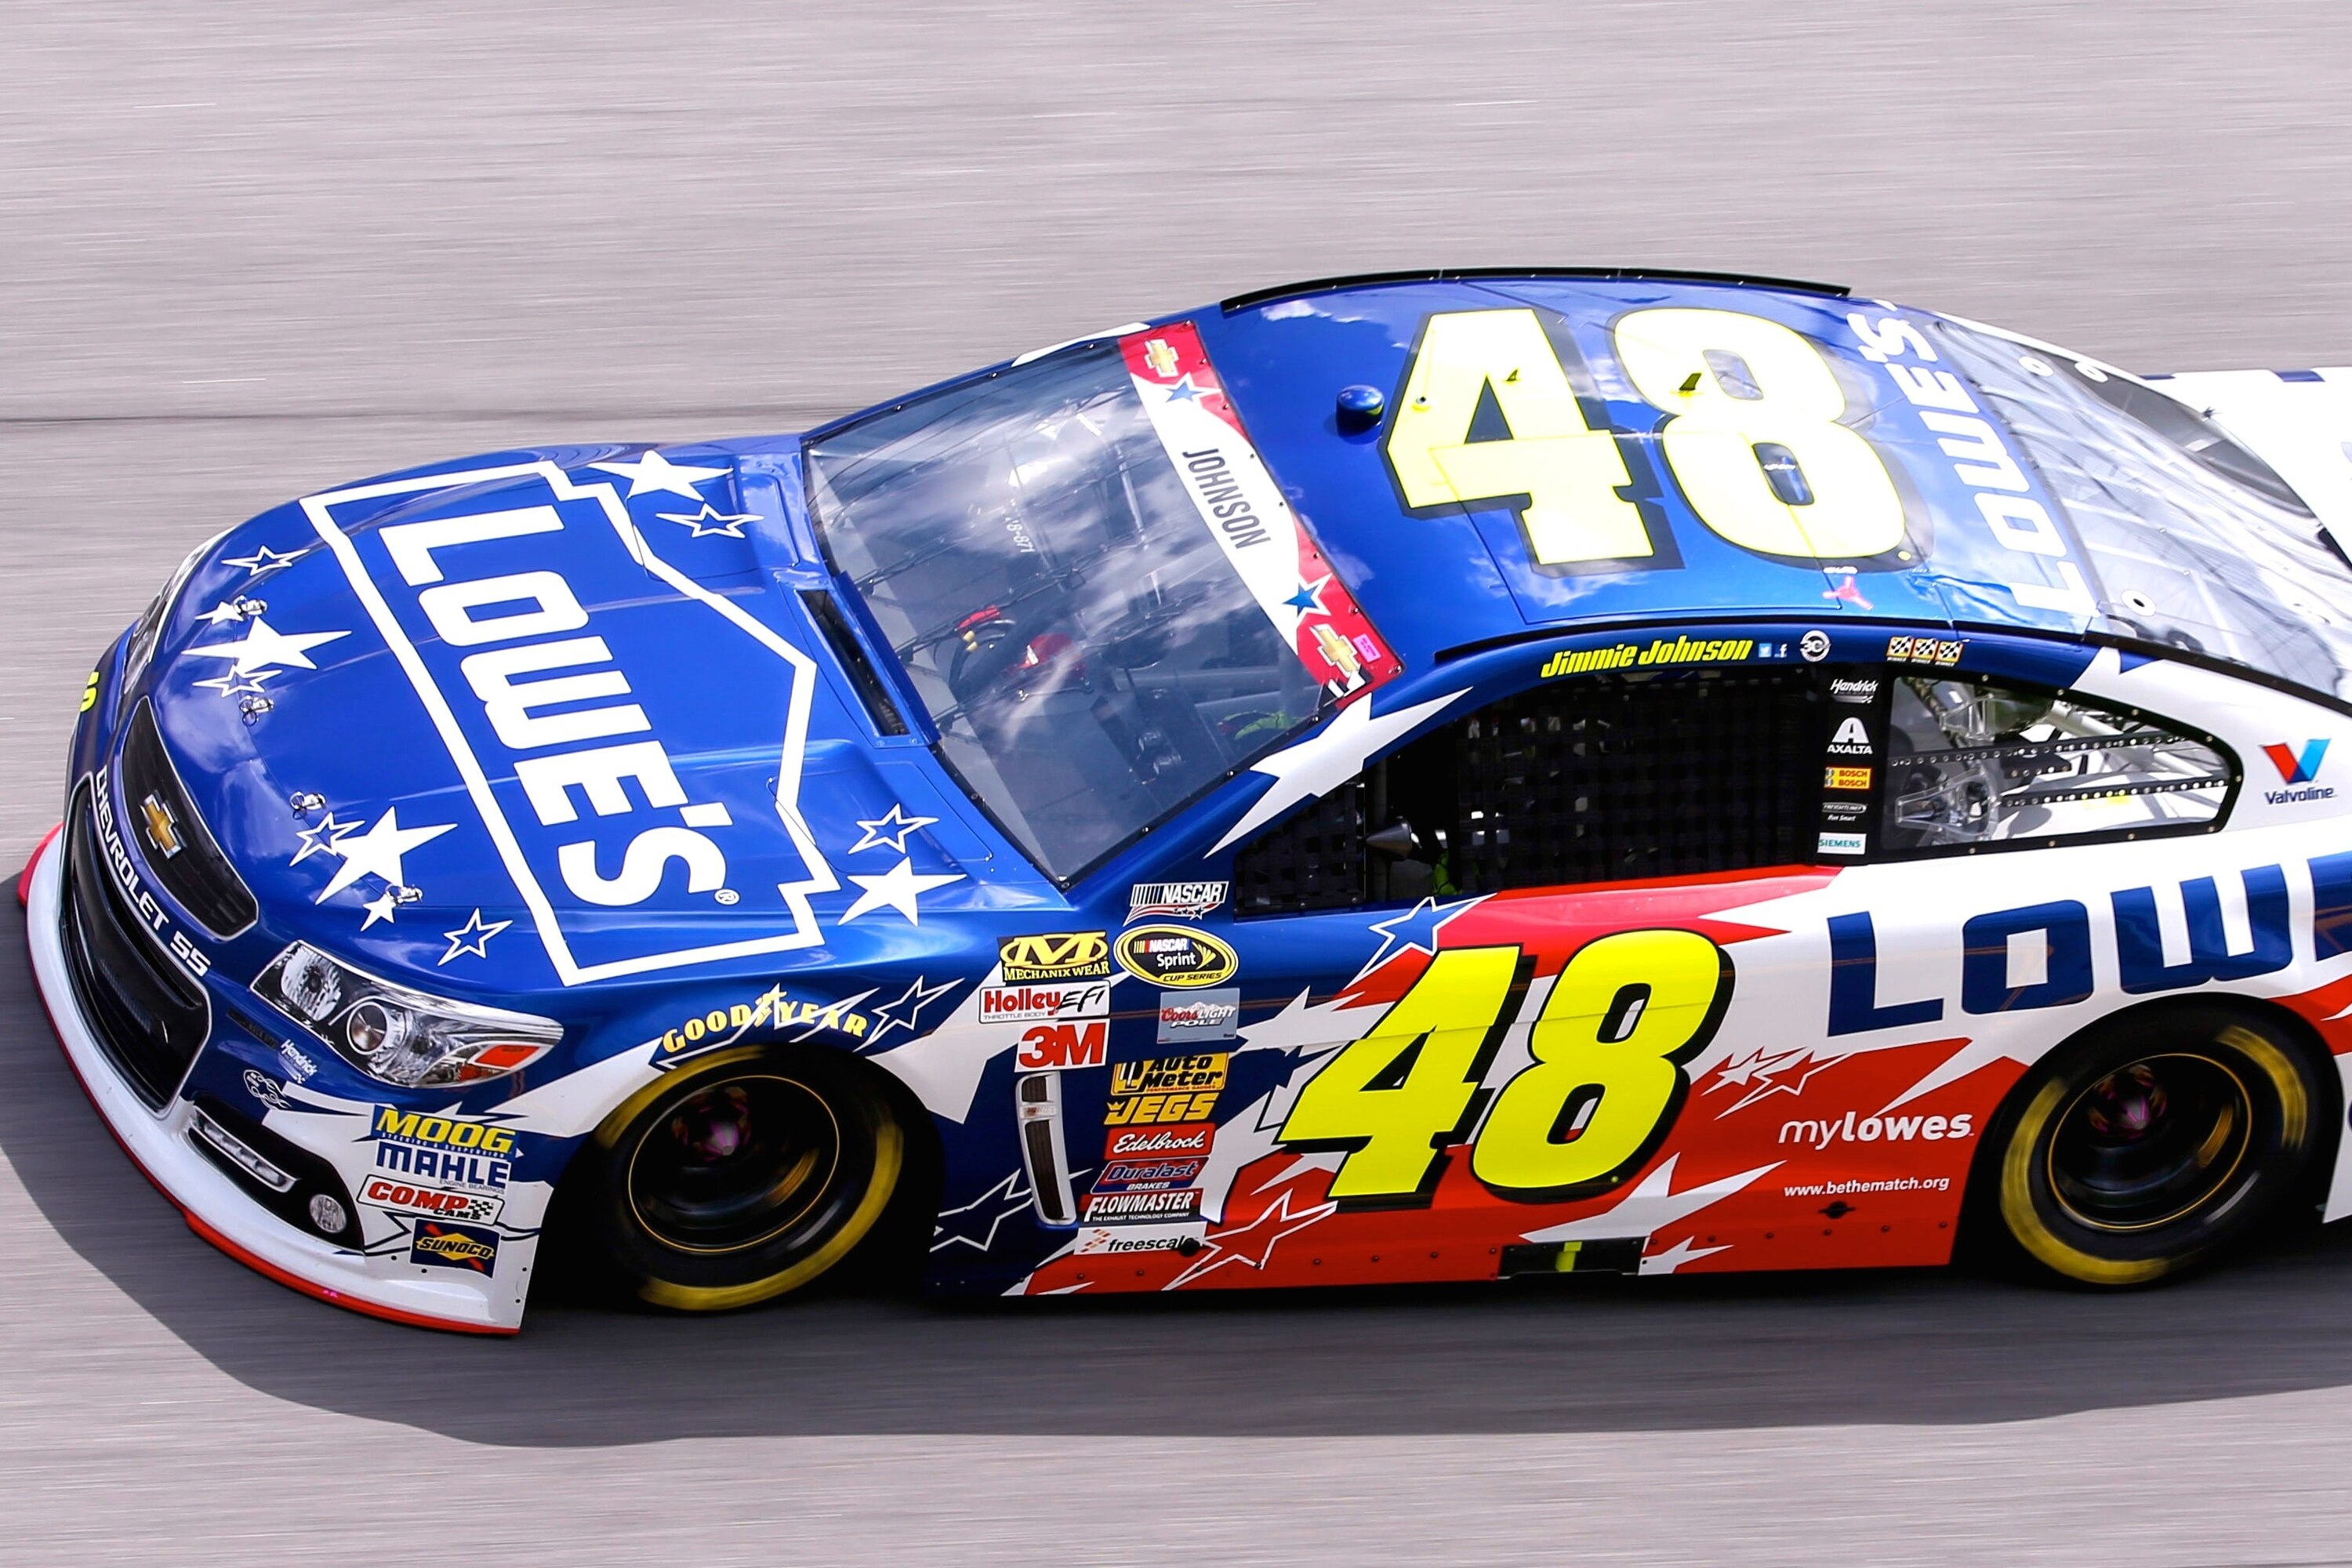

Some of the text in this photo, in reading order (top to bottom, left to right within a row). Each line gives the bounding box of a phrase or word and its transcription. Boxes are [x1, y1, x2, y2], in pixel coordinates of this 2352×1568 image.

[1384, 306, 1910, 561] 48
[1846, 312, 2101, 618] LOWE'S
[1182, 448, 1272, 550] JOHNSON
[1541, 635, 1753, 678] Jimmie Johnson
[1830, 678, 1878, 694] Hendrick
[379, 504, 733, 906] LOWE'S
[1826, 744, 1874, 754] AXALTA
[1838, 779, 1867, 787] BOSCH
[2264, 786, 2337, 805] Valvoline
[1818, 838, 1861, 848] SIEMENS
[96, 764, 212, 977] CHEVROLET SS
[1160, 883, 1223, 904] NASCAR
[1149, 938, 1189, 953] NASCAR
[1004, 960, 1110, 981] MECHANIX WEAR
[1156, 951, 1196, 971] Sprint
[1185, 971, 1223, 981] SERIES
[984, 985, 1107, 1017] Holley EFI
[1161, 1005, 1236, 1022] Coors LIGHT
[1170, 1018, 1225, 1029] POLE
[1018, 1022, 1107, 1069] 3M
[281, 1039, 318, 1076] Hendrick
[1275, 928, 1735, 1209] 48
[1139, 1070, 1223, 1092] Meter
[1104, 1092, 1220, 1125] JEGS
[376, 1109, 517, 1154] MOOG
[1778, 1111, 1973, 1150] mylowes
[1112, 1131, 1206, 1153] Edelbrock
[376, 1141, 510, 1189] MAHLE
[1105, 1160, 1199, 1182] Duralast
[368, 1181, 469, 1211] COMP
[438, 1179, 506, 1196] ENGINE BEARINGS
[1126, 1181, 1171, 1191] BRAKES
[1784, 1177, 1951, 1197] www.bethematch.org
[433, 1207, 483, 1221] CAMS
[1083, 1191, 1195, 1223] FLOWMASTER
[417, 1236, 494, 1259] SUNOCO
